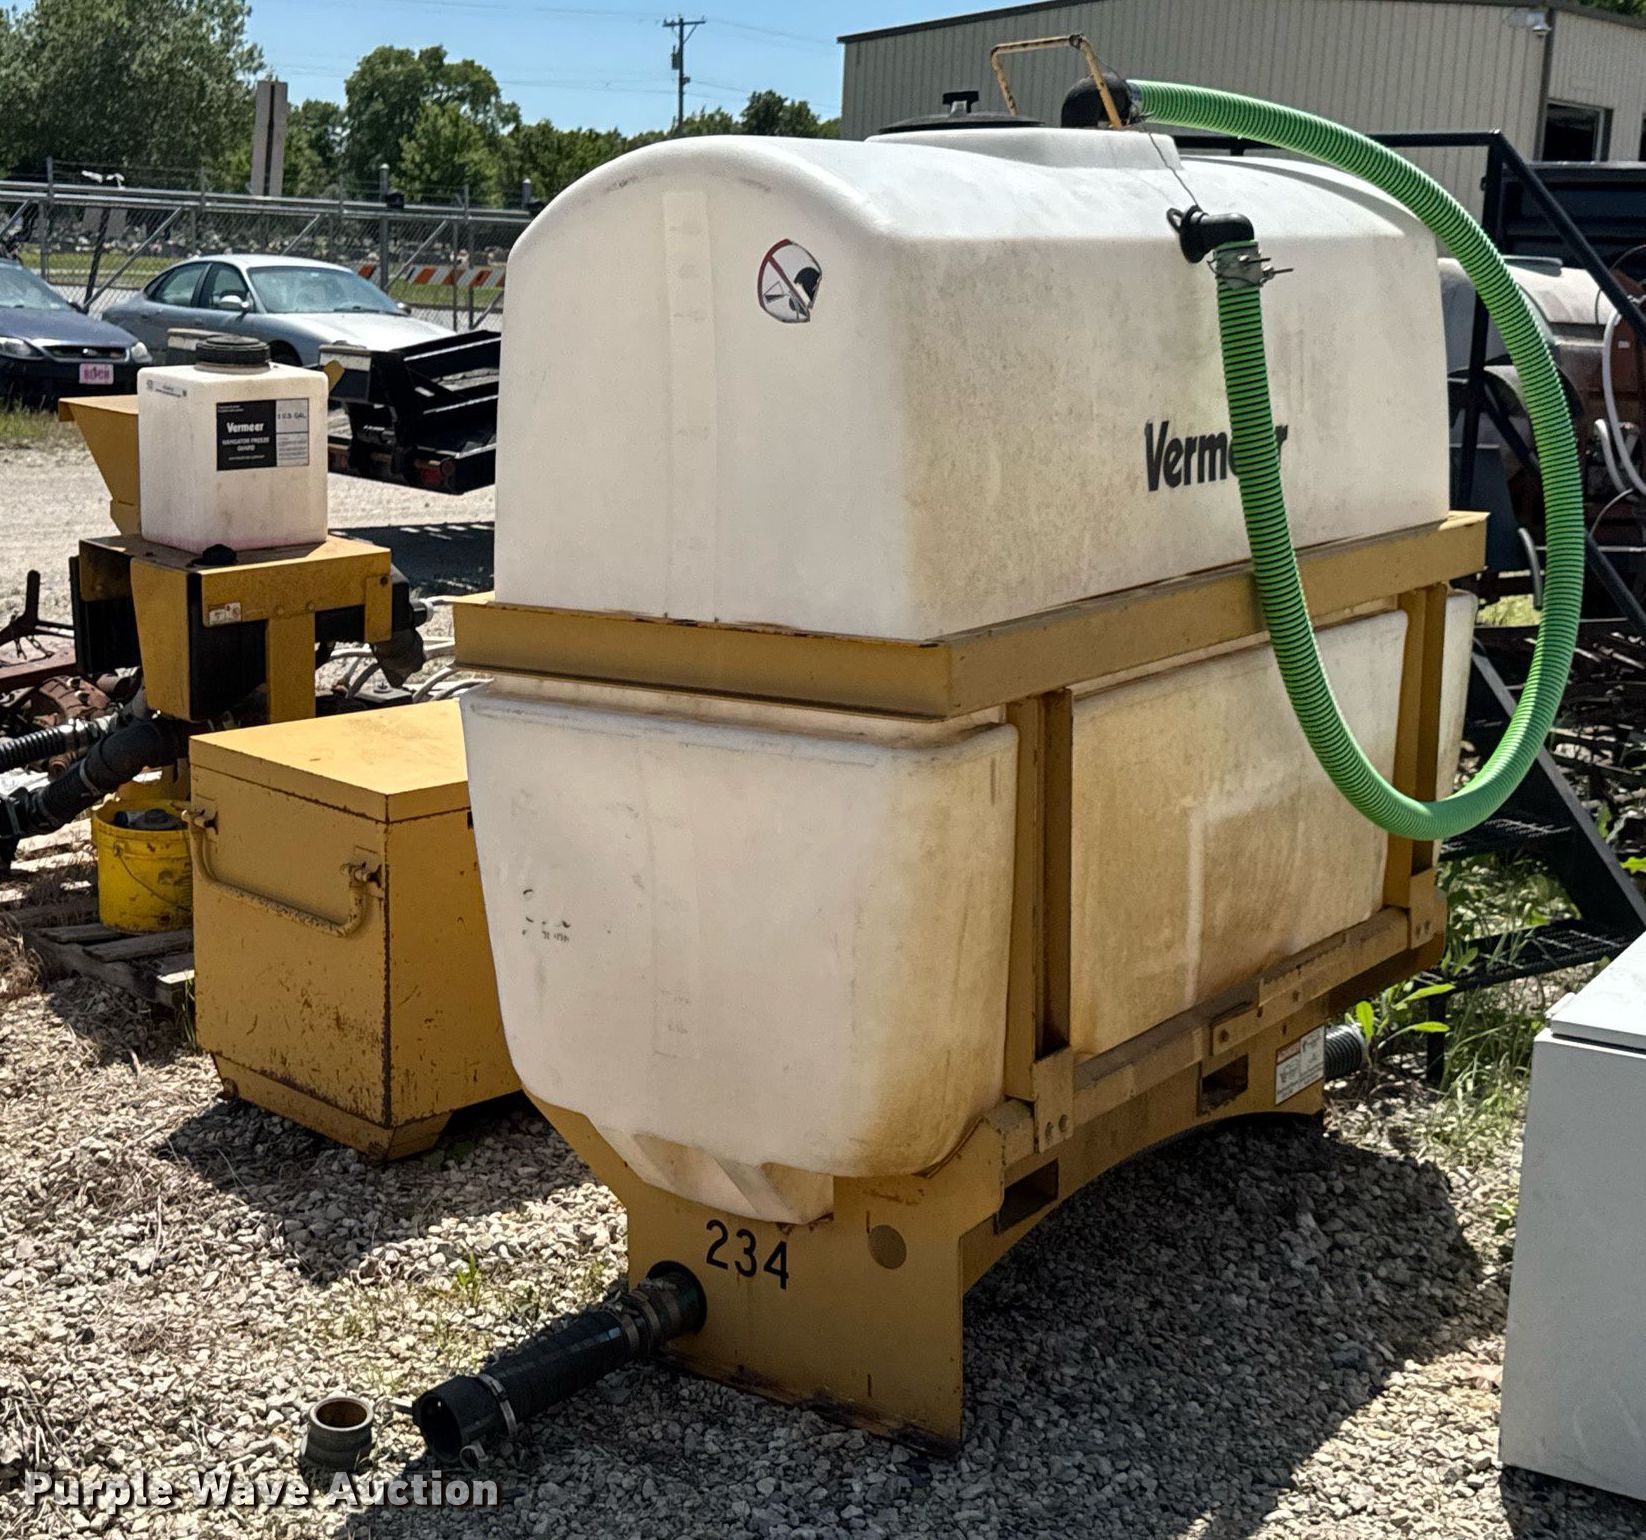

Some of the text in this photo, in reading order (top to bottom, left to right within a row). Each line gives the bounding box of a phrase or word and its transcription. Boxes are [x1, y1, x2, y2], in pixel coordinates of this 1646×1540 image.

[226, 421, 264, 434] Vermeer
[1144, 420, 1289, 492] Vermr
[705, 1219, 789, 1290] 234
